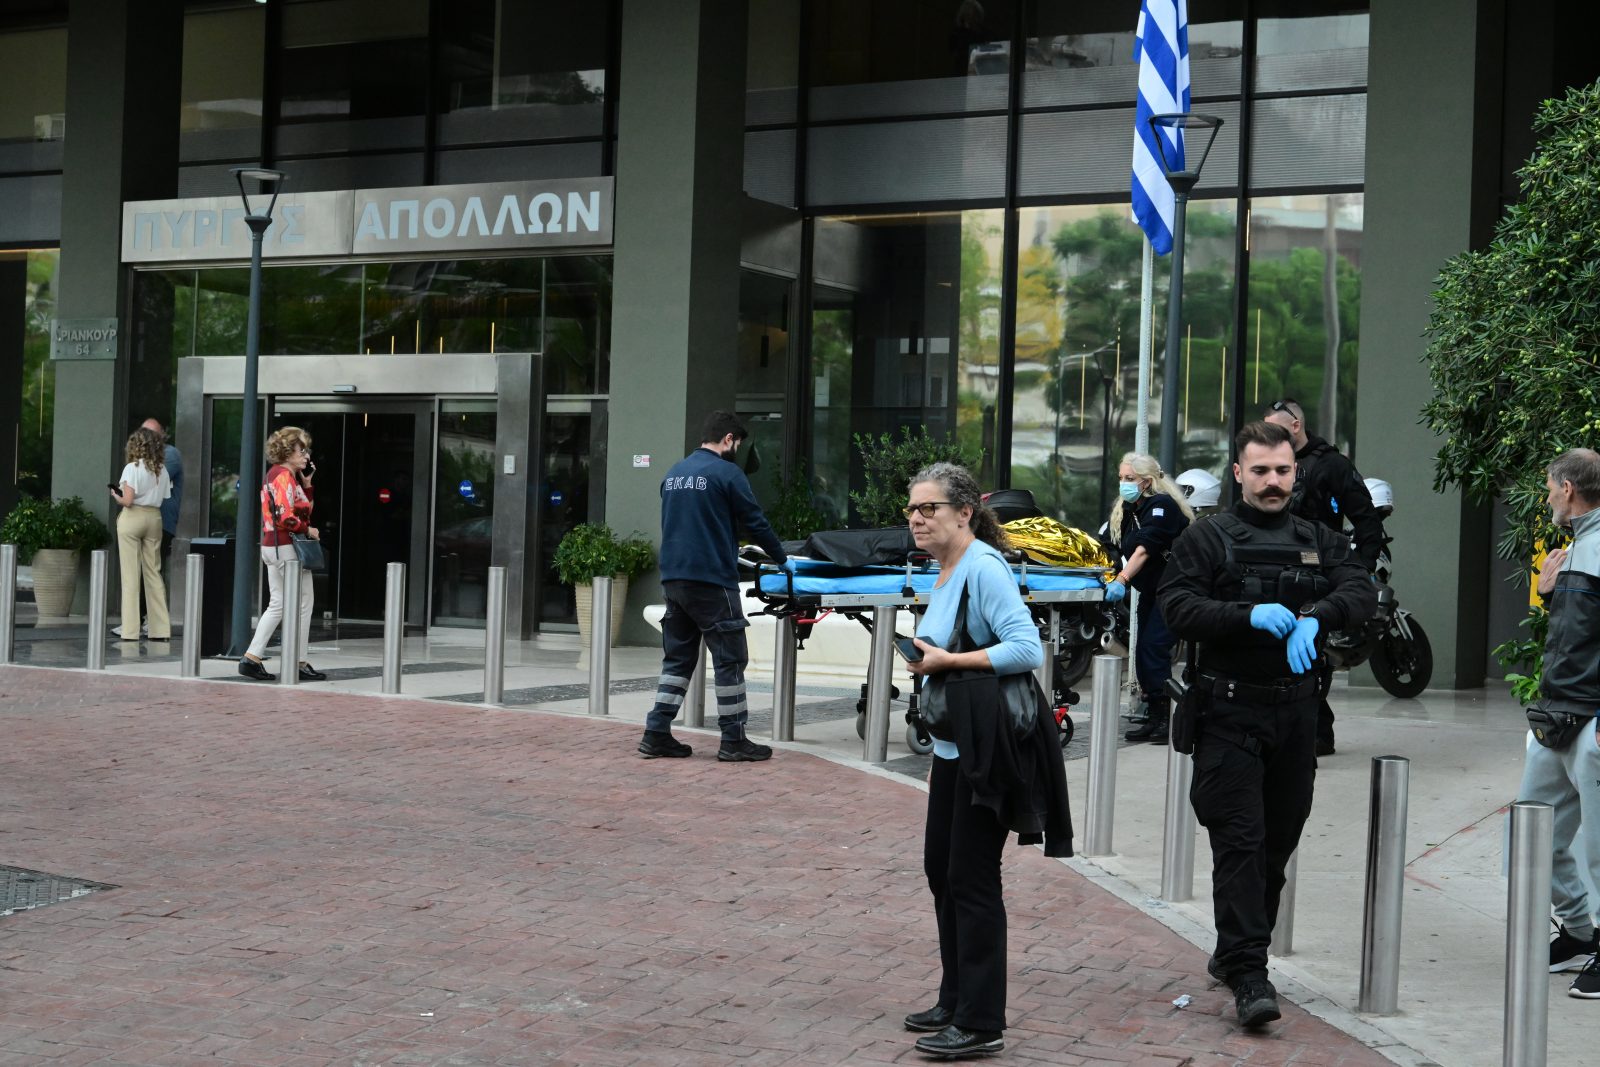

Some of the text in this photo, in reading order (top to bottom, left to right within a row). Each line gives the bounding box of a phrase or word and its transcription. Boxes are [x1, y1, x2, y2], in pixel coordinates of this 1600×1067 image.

[354, 191, 601, 241] ΑΠΟΛΛΩΝ
[75, 343, 89, 355] 64
[665, 475, 708, 491] ΕΚΑΒ
